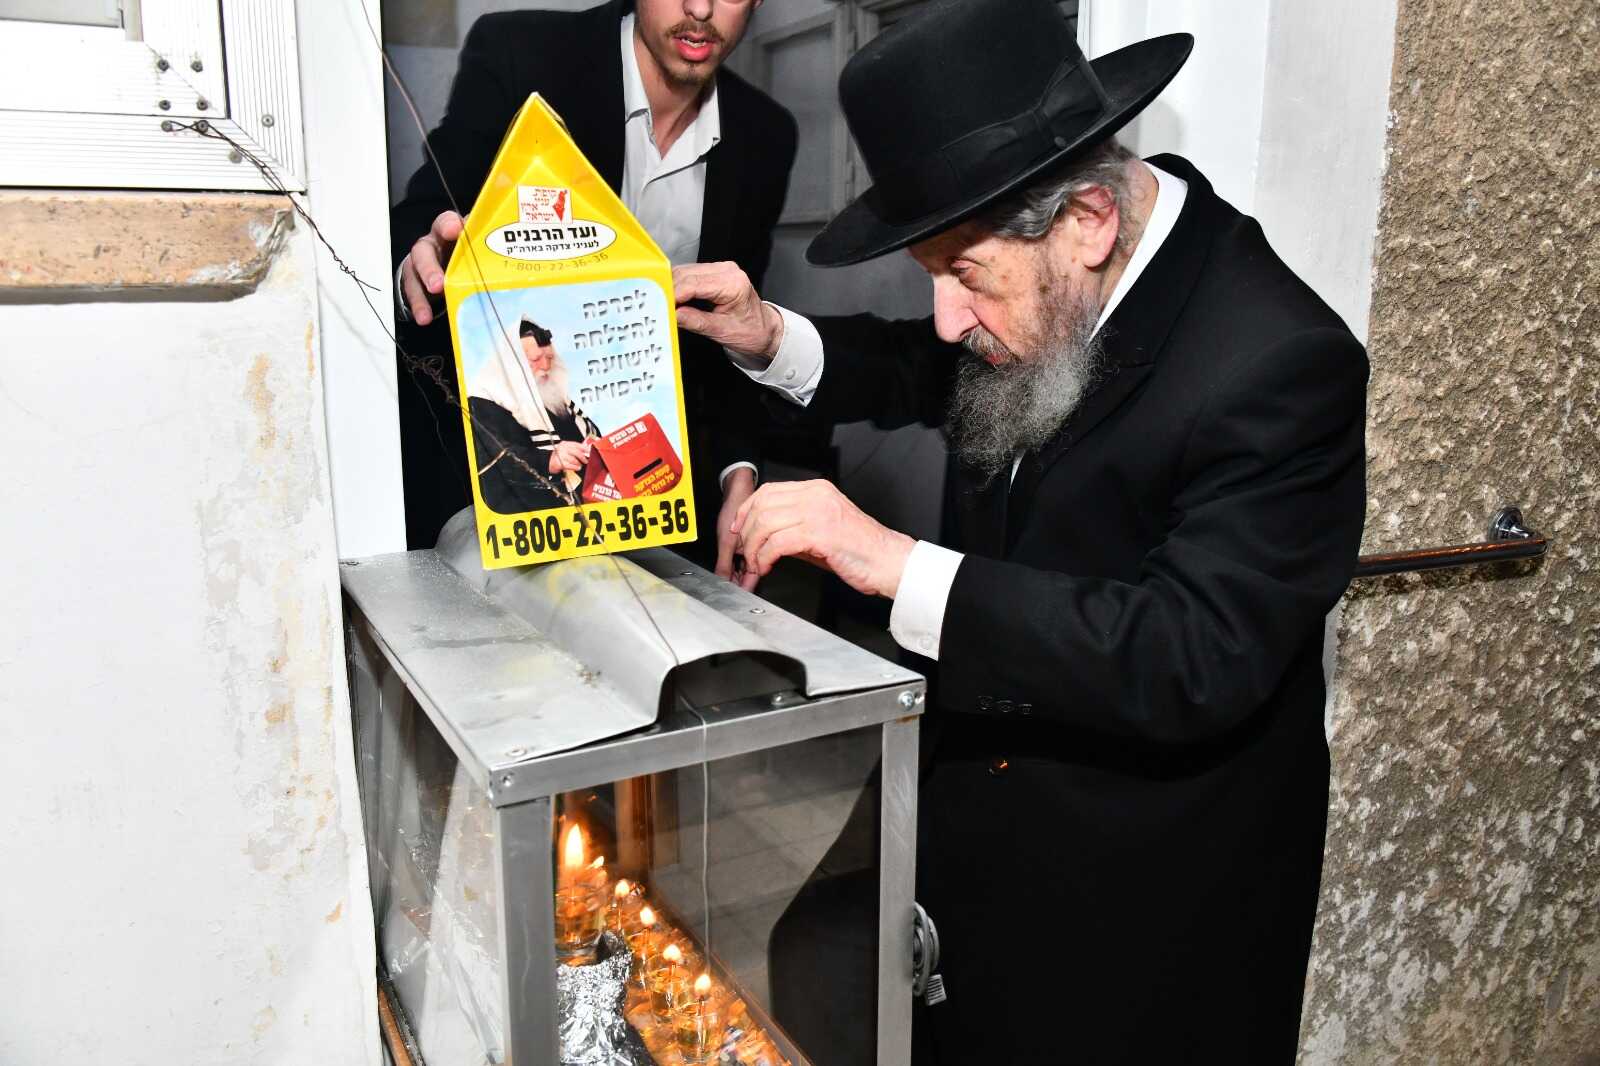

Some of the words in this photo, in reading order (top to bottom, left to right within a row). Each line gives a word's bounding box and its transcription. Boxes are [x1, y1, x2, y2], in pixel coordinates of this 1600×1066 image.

[503, 228, 564, 243] הרבנים
[567, 226, 597, 239] ועד
[573, 240, 599, 249] לעניני
[545, 243, 571, 252] צדקה
[503, 252, 608, 272] 1-800-22-36-36
[583, 289, 647, 319] לברכה
[573, 316, 656, 350] להצלחה
[587, 343, 662, 376] לישועה
[580, 371, 655, 404] לרפואה
[486, 498, 689, 560] 1-800-22-36-36
